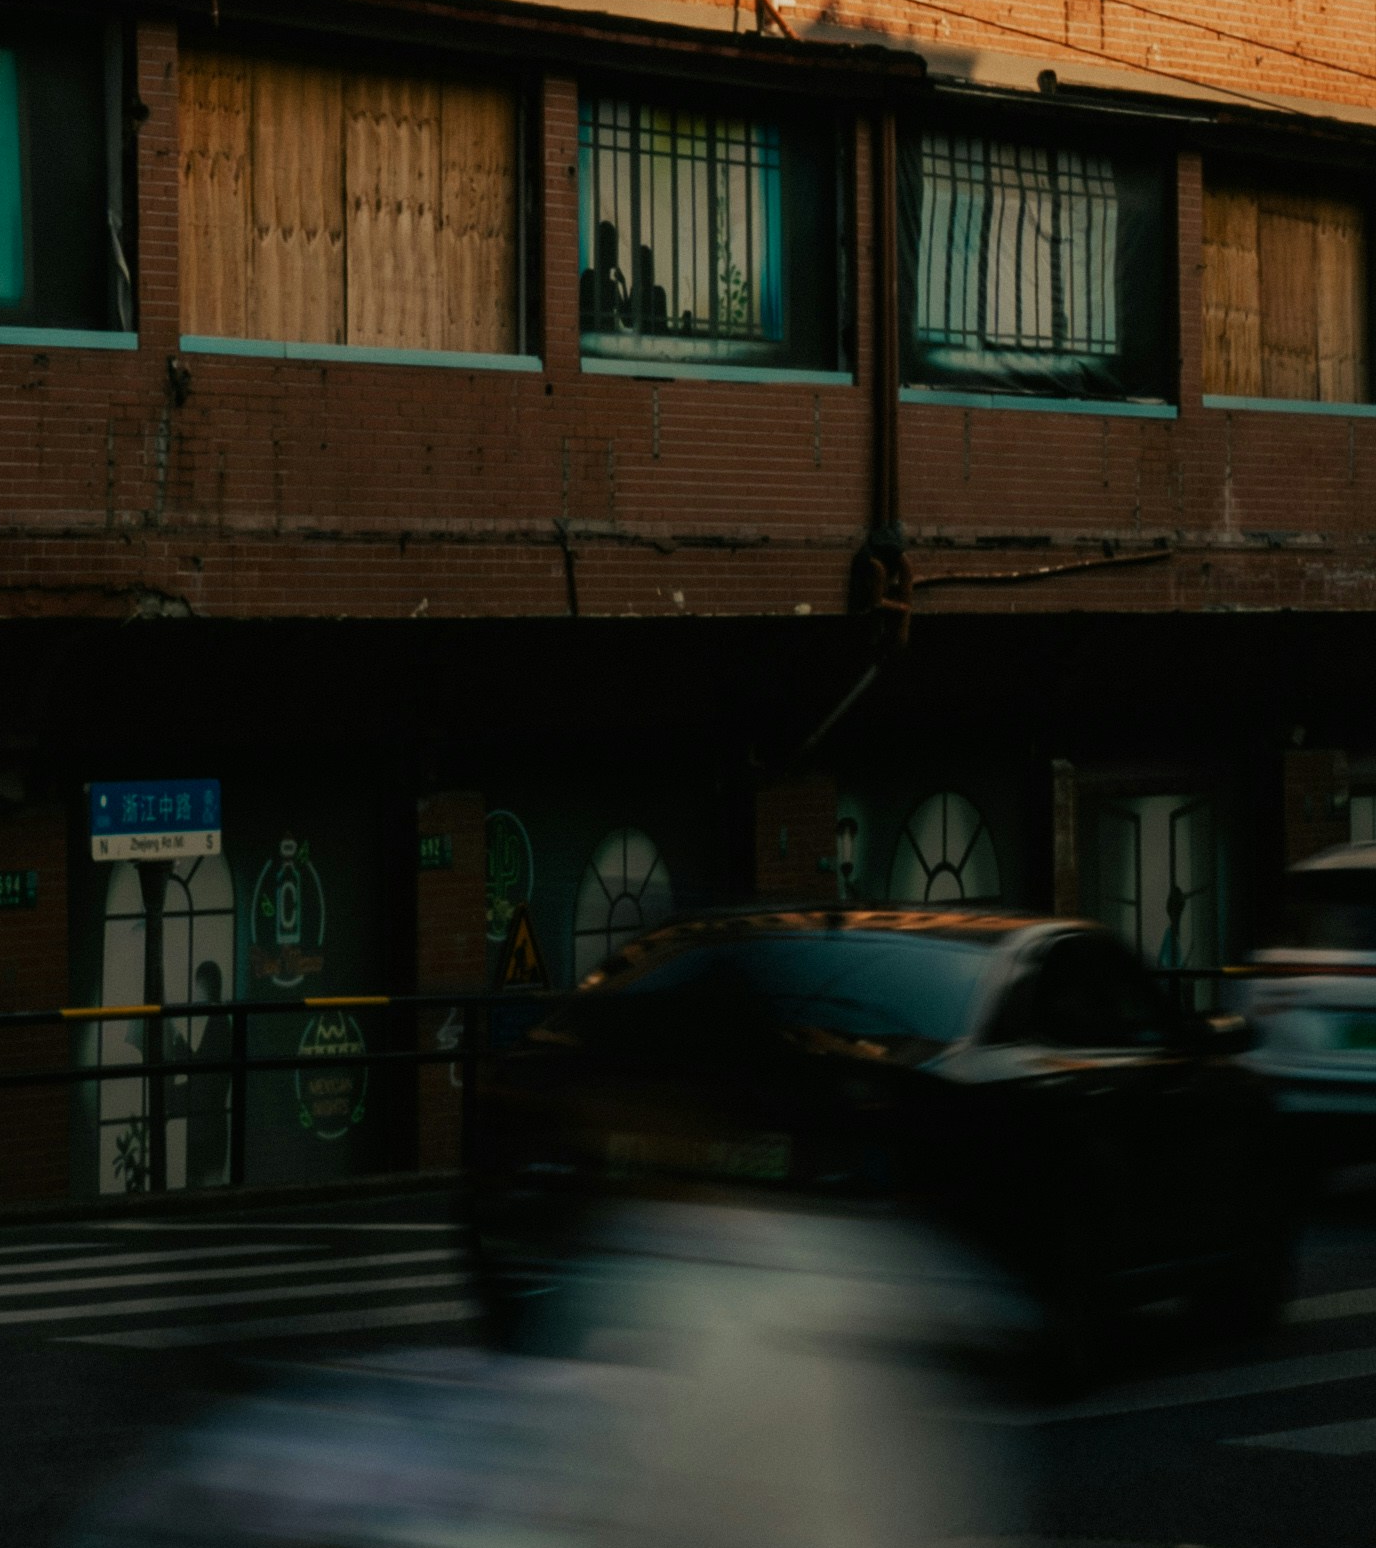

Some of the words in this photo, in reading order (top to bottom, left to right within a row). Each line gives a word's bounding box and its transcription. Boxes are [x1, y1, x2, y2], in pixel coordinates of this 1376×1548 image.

[122, 792, 192, 824] 浙江中路
[99, 838, 108, 855] N
[206, 834, 214, 850] S
